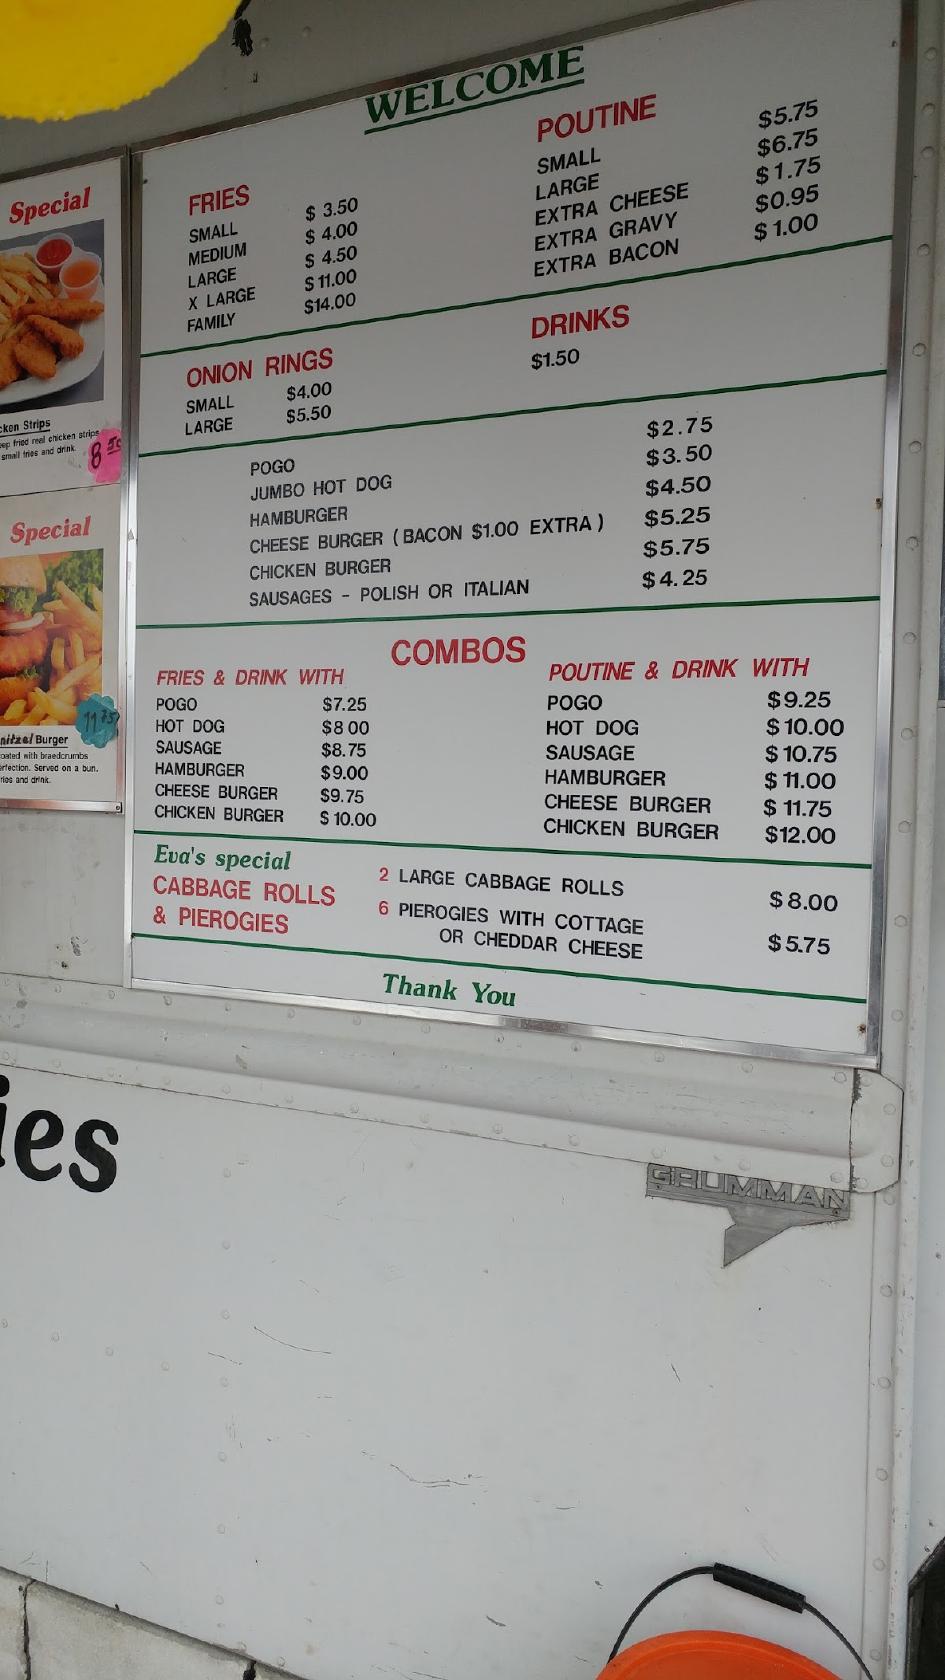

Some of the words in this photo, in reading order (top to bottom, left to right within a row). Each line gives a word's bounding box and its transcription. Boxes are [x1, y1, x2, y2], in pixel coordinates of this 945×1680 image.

[365, 45, 584, 123] WELCOME
[538, 94, 656, 142] POUTINE
[758, 128, 818, 158] $6.75
[537, 147, 601, 175] SMALL
[536, 173, 599, 200] LARGE
[9, 186, 91, 226] Special
[190, 185, 249, 216] FRIES
[536, 200, 598, 226] EXTRA
[610, 182, 689, 213] CHEESE
[756, 184, 818, 214] $0.95
[190, 222, 238, 243] SMALL
[535, 227, 597, 251] EXTRA
[609, 212, 678, 239] GRAVY
[189, 242, 246, 266] MEDIUM
[535, 253, 596, 277] EXTRA
[610, 238, 678, 265] BACON
[189, 267, 236, 288] LARGE
[189, 296, 197, 310] X
[207, 287, 255, 307] LARGE
[304, 293, 356, 314] $14.00
[188, 313, 235, 332] FAMILY
[532, 305, 629, 339] DRINKS
[187, 360, 252, 387] ONION
[266, 348, 332, 376] RINGS
[532, 349, 579, 370] $1.50
[287, 382, 331, 401] $4.00
[187, 396, 234, 414] SMALL
[287, 405, 331, 424] $5.50
[24, 419, 50, 430] Strips
[186, 417, 232, 435] LARGE
[647, 416, 712, 439] $2.75
[32, 436, 45, 444] real
[49, 433, 75, 442] chicken
[79, 430, 99, 438] strips
[2, 451, 20, 460] small
[42, 447, 54, 455] and
[647, 444, 712, 467] $3.50
[251, 459, 295, 476] POGO
[251, 483, 304, 501] JUMBO
[314, 479, 346, 495] HOT
[357, 475, 391, 492] DOG
[646, 476, 711, 497] $4.50
[250, 506, 347, 527] HAMBURGER
[645, 507, 710, 528] $5.25
[10, 516, 91, 545] Special
[250, 536, 309, 554] CHEESE
[319, 532, 383, 549] BURGER
[250, 563, 315, 580] CHICKEN
[326, 559, 390, 576] BURGER
[250, 589, 331, 606] SAUSAGES
[361, 585, 418, 601] POLISH
[429, 584, 452, 599] OR
[465, 579, 529, 596] ITALIAN
[392, 636, 525, 666] COMBOS
[157, 670, 204, 685] FRIES
[214, 670, 224, 685] &
[236, 669, 287, 685] DRINK
[300, 669, 344, 684] WITH
[549, 662, 635, 681] POUTINE
[645, 661, 658, 680] &
[672, 659, 738, 679] DRINK
[754, 658, 809, 677] WITH
[157, 698, 197, 711] POGO
[323, 697, 366, 712] $7.25
[548, 695, 602, 710] POGO
[768, 691, 831, 710] $9.25
[156, 719, 184, 732] HOT
[193, 720, 224, 733] DOG
[547, 720, 584, 735] HOT
[596, 720, 638, 736] DOG
[36, 735, 68, 746] Burger
[156, 740, 221, 754] SAUSAGE
[322, 742, 366, 758] $8.75
[546, 745, 635, 761] SAUSAGE
[156, 762, 244, 777] HAMBURGER
[321, 765, 368, 781] $9.00
[546, 770, 665, 786] HAMBURGER
[155, 784, 209, 798] CHEESE
[219, 785, 277, 800] BURGER
[321, 788, 364, 803] $9.75
[155, 805, 215, 819] CHICKEN
[224, 808, 283, 822] BURGER
[545, 794, 617, 810] CHEESE
[630, 796, 711, 813] BURGER
[544, 818, 624, 836] CHICKEN
[637, 822, 718, 839] BURGER
[766, 826, 835, 844] $12.00
[154, 844, 205, 865] Eva's
[216, 851, 291, 871] special
[154, 876, 251, 900] CABBAGE
[264, 883, 335, 906] ROLLS
[380, 868, 388, 881] 2
[400, 869, 454, 885] LARGE
[466, 873, 550, 891] CABBAGE
[562, 878, 623, 896] ROLLS
[153, 906, 166, 924] &
[179, 907, 288, 934] PIEROGIES
[379, 901, 388, 915] 6
[400, 903, 488, 922] PIEROGIES
[500, 910, 544, 926] WITH
[555, 914, 643, 935] COTTAGE
[440, 929, 463, 943] OR
[474, 931, 557, 952] CHEDDAR
[568, 937, 643, 960] CHEESE
[383, 974, 457, 1000] Thank
[472, 982, 515, 1006] You
[649, 1163, 849, 1209] GRUMMAN
